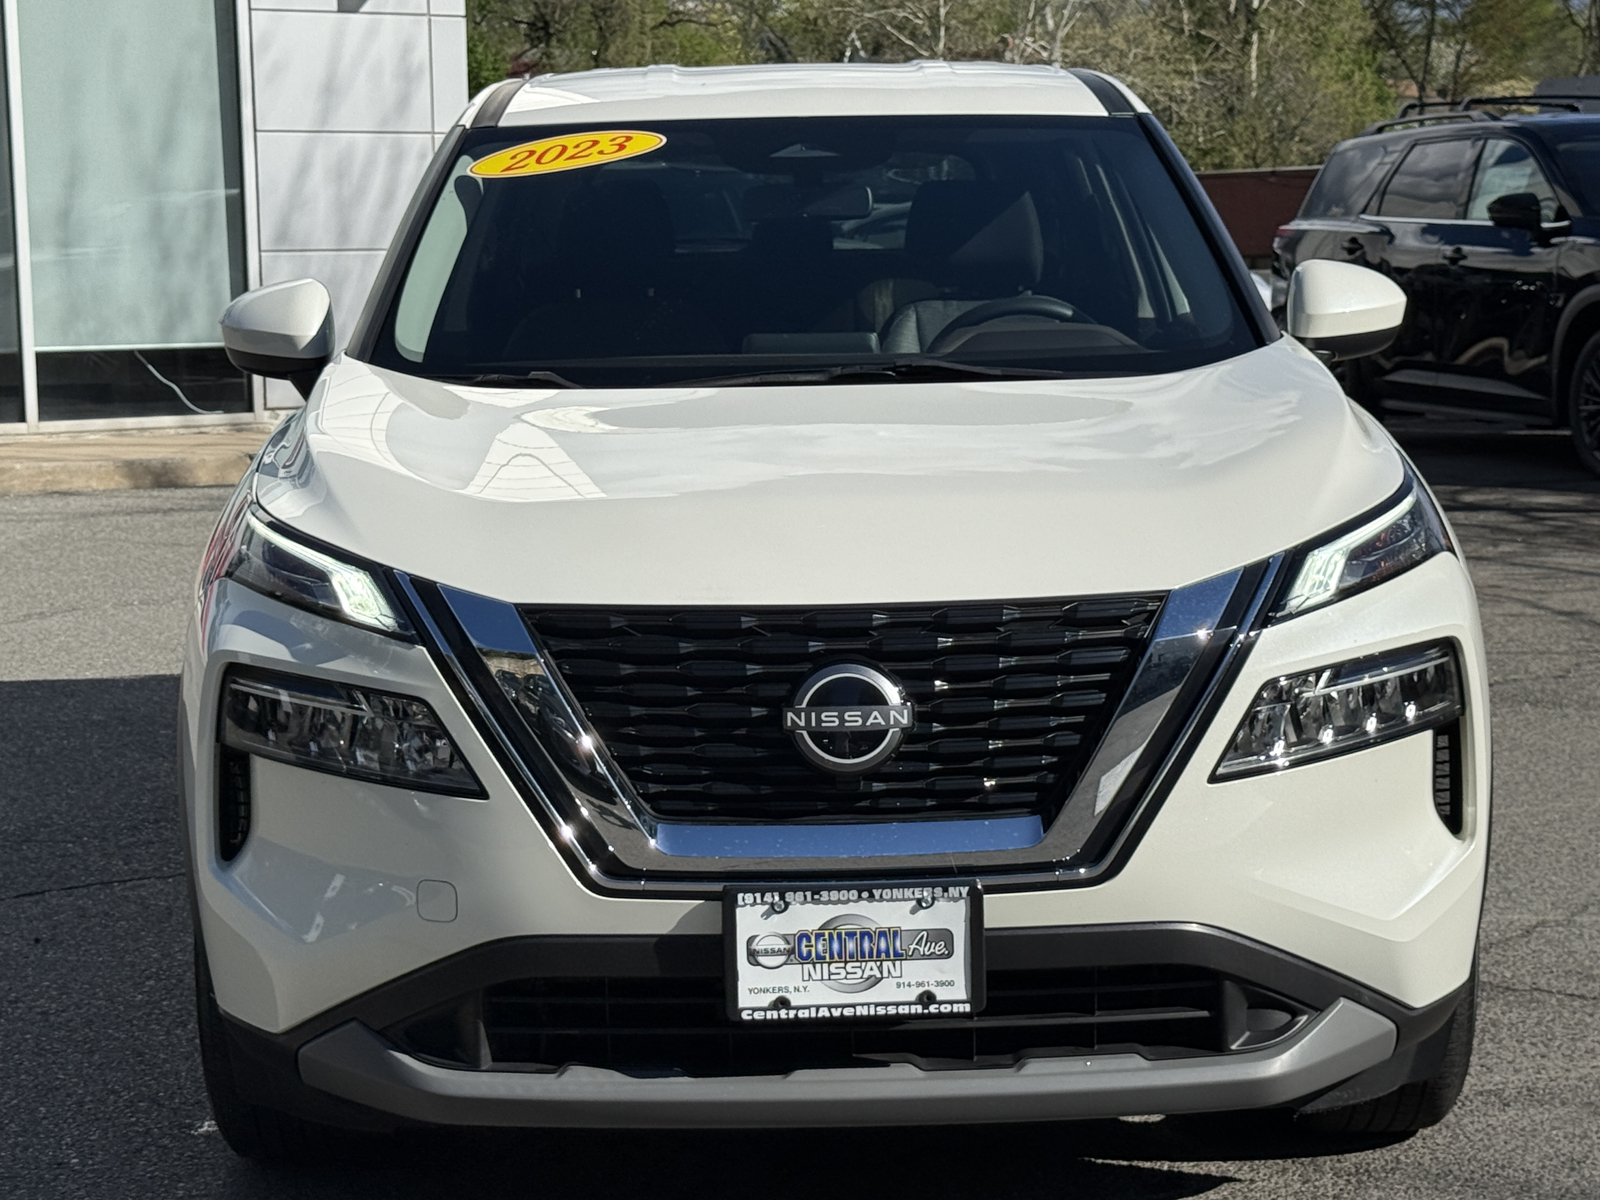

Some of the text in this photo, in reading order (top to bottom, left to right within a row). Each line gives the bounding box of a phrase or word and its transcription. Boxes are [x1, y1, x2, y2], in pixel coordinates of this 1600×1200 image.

[500, 135, 634, 173] 2023
[786, 709, 908, 727] NISSAN
[785, 889, 859, 902] 961-3900
[752, 947, 791, 955] NISSAN
[796, 927, 950, 962] CENTRAL Ave.
[802, 961, 902, 981] NISSAN
[747, 985, 810, 995] YONKERS, N.Y.
[896, 980, 955, 989] 914-961-3900
